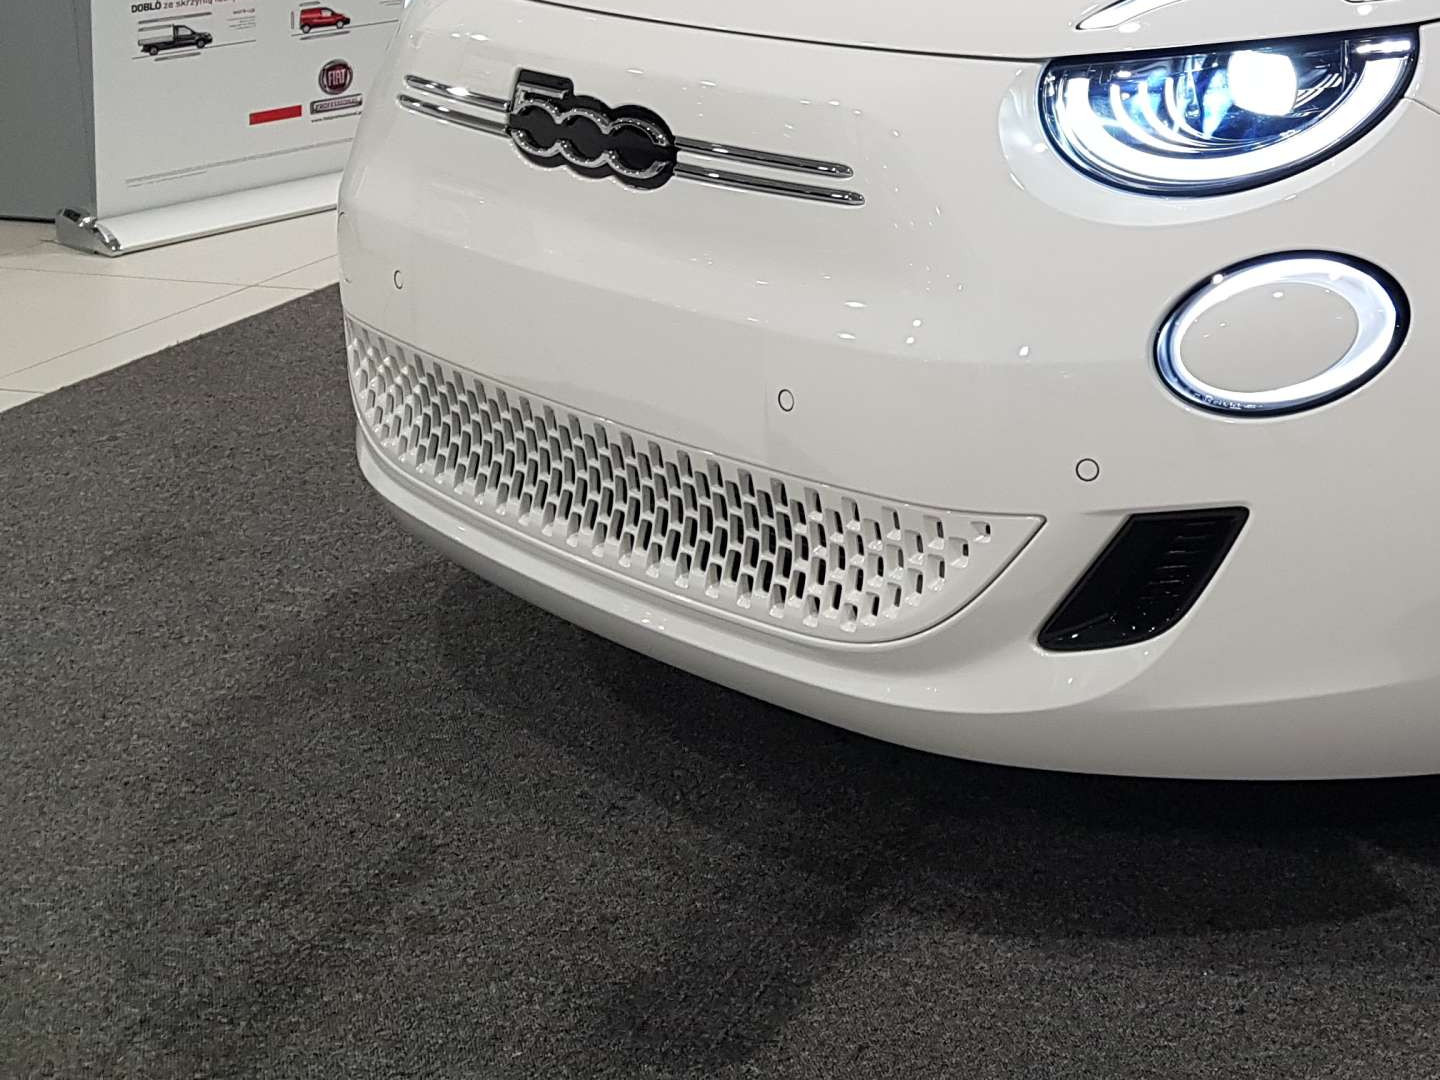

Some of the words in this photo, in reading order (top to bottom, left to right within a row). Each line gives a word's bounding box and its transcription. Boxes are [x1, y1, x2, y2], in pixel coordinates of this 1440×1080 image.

[131, 0, 162, 14] DOBLÒ
[163, 2, 174, 10] ze
[509, 68, 677, 192] 500
